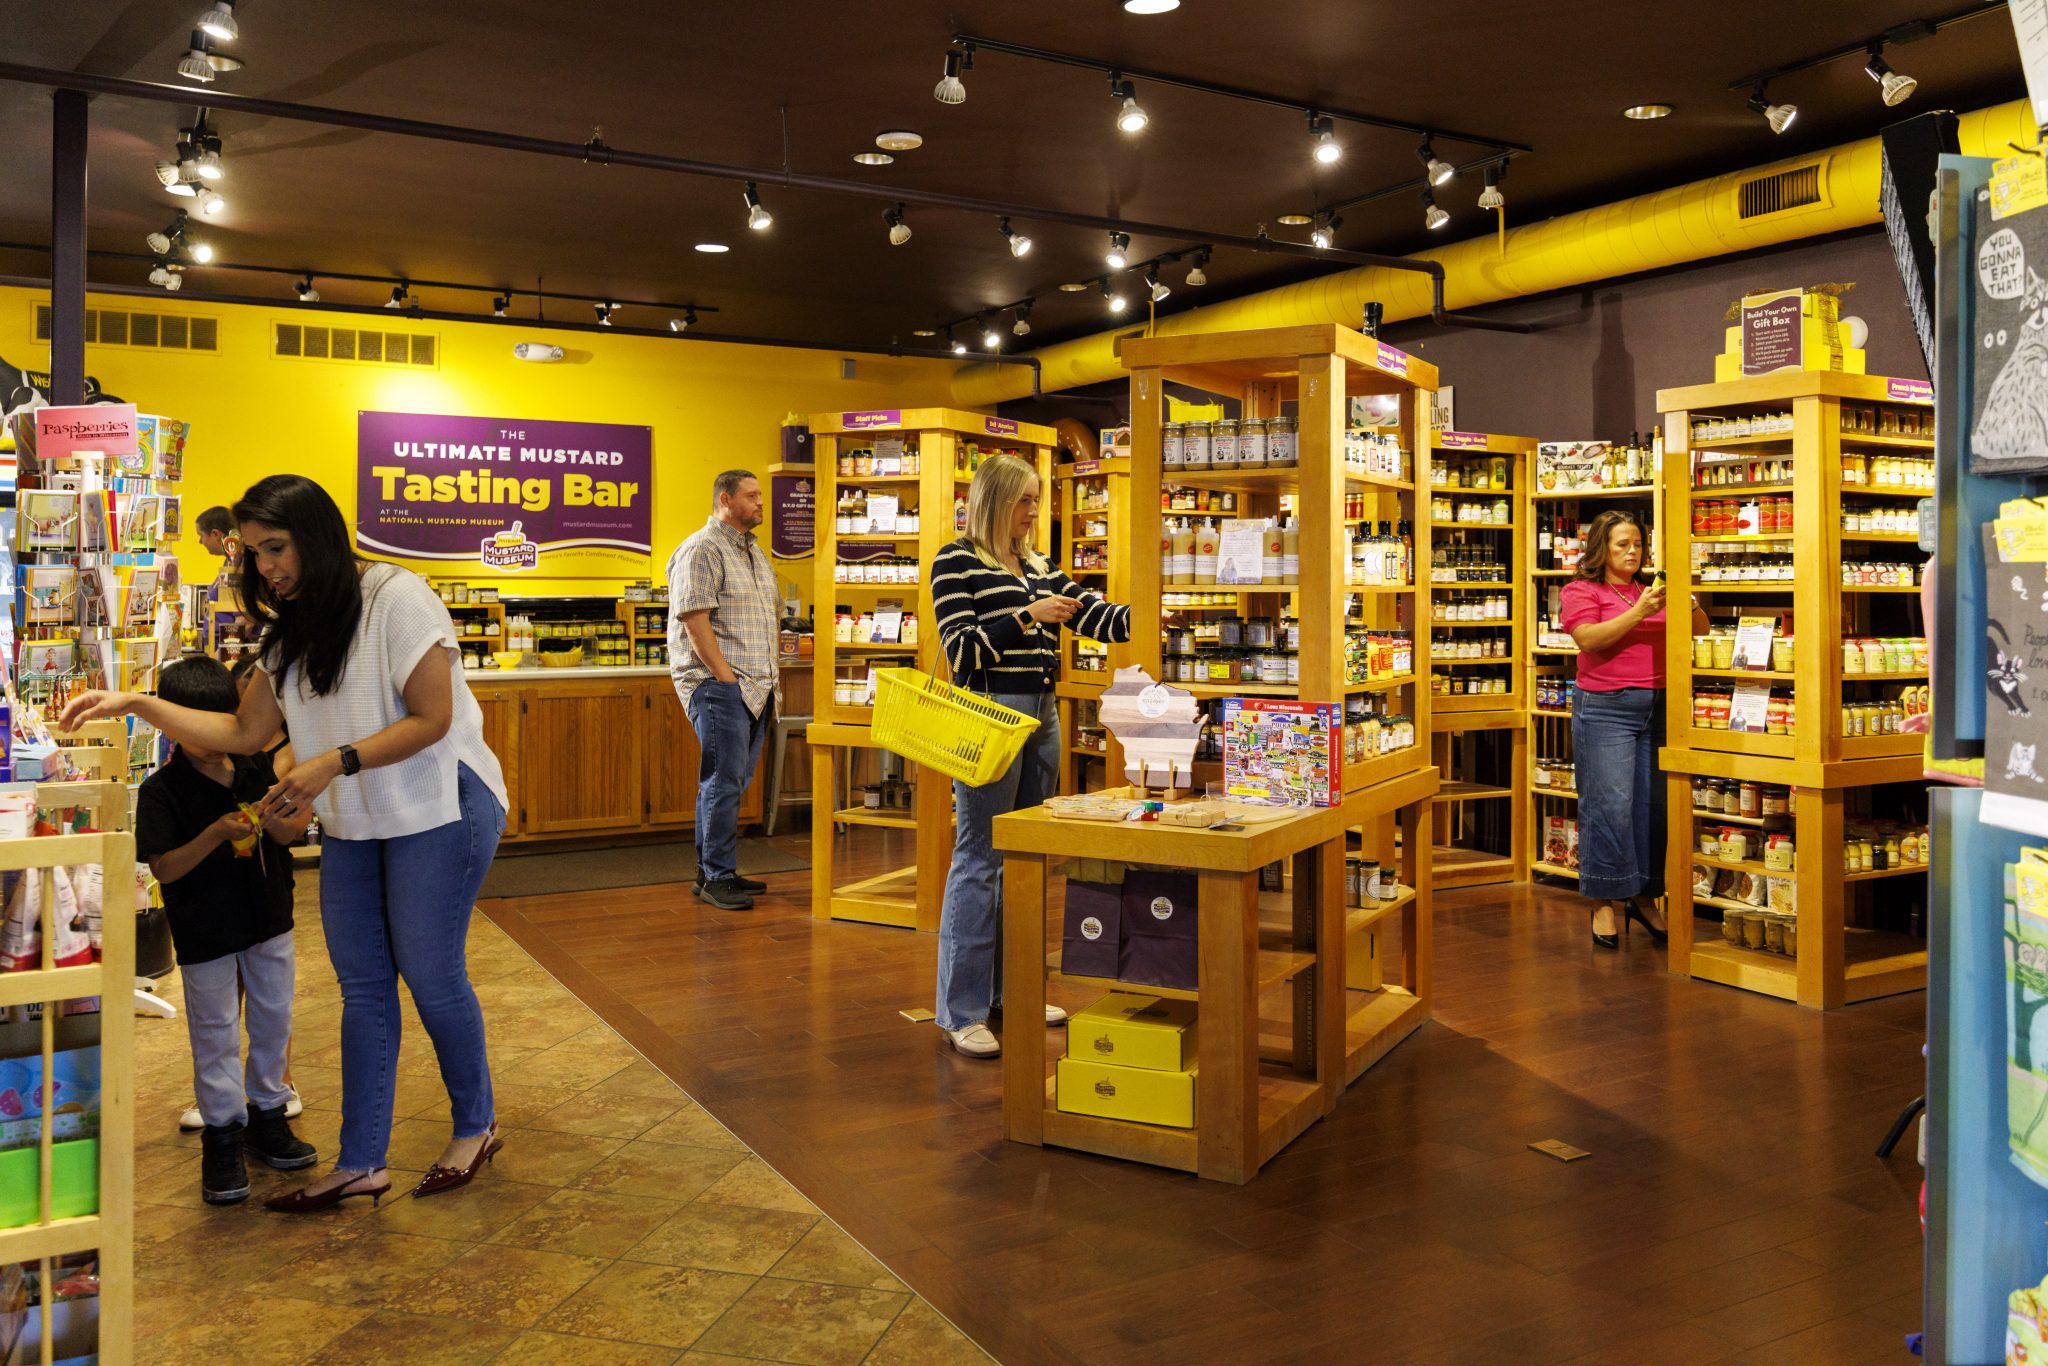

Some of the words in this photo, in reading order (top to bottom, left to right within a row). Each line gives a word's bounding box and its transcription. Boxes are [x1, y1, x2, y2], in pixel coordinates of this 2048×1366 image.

[1989, 234, 2012, 250] YOU
[1980, 246, 2021, 270] GONNA
[1991, 263, 2016, 281] EAT
[1988, 275, 2023, 295] THAT?
[1747, 310, 1763, 319] Build
[1753, 318, 1771, 328] Gift
[1773, 316, 1790, 326] Box
[42, 421, 129, 438] raspberries
[500, 430, 526, 440] THE
[393, 441, 511, 461] ULTIMATE
[520, 447, 624, 466] MUSTARD
[372, 466, 551, 512] Tasting
[563, 473, 638, 508] Bar
[379, 516, 424, 524] NATIONAL
[563, 521, 633, 529] mustardmuseum.com
[485, 545, 535, 555] MUSTARD
[485, 554, 535, 565] MUSEUM
